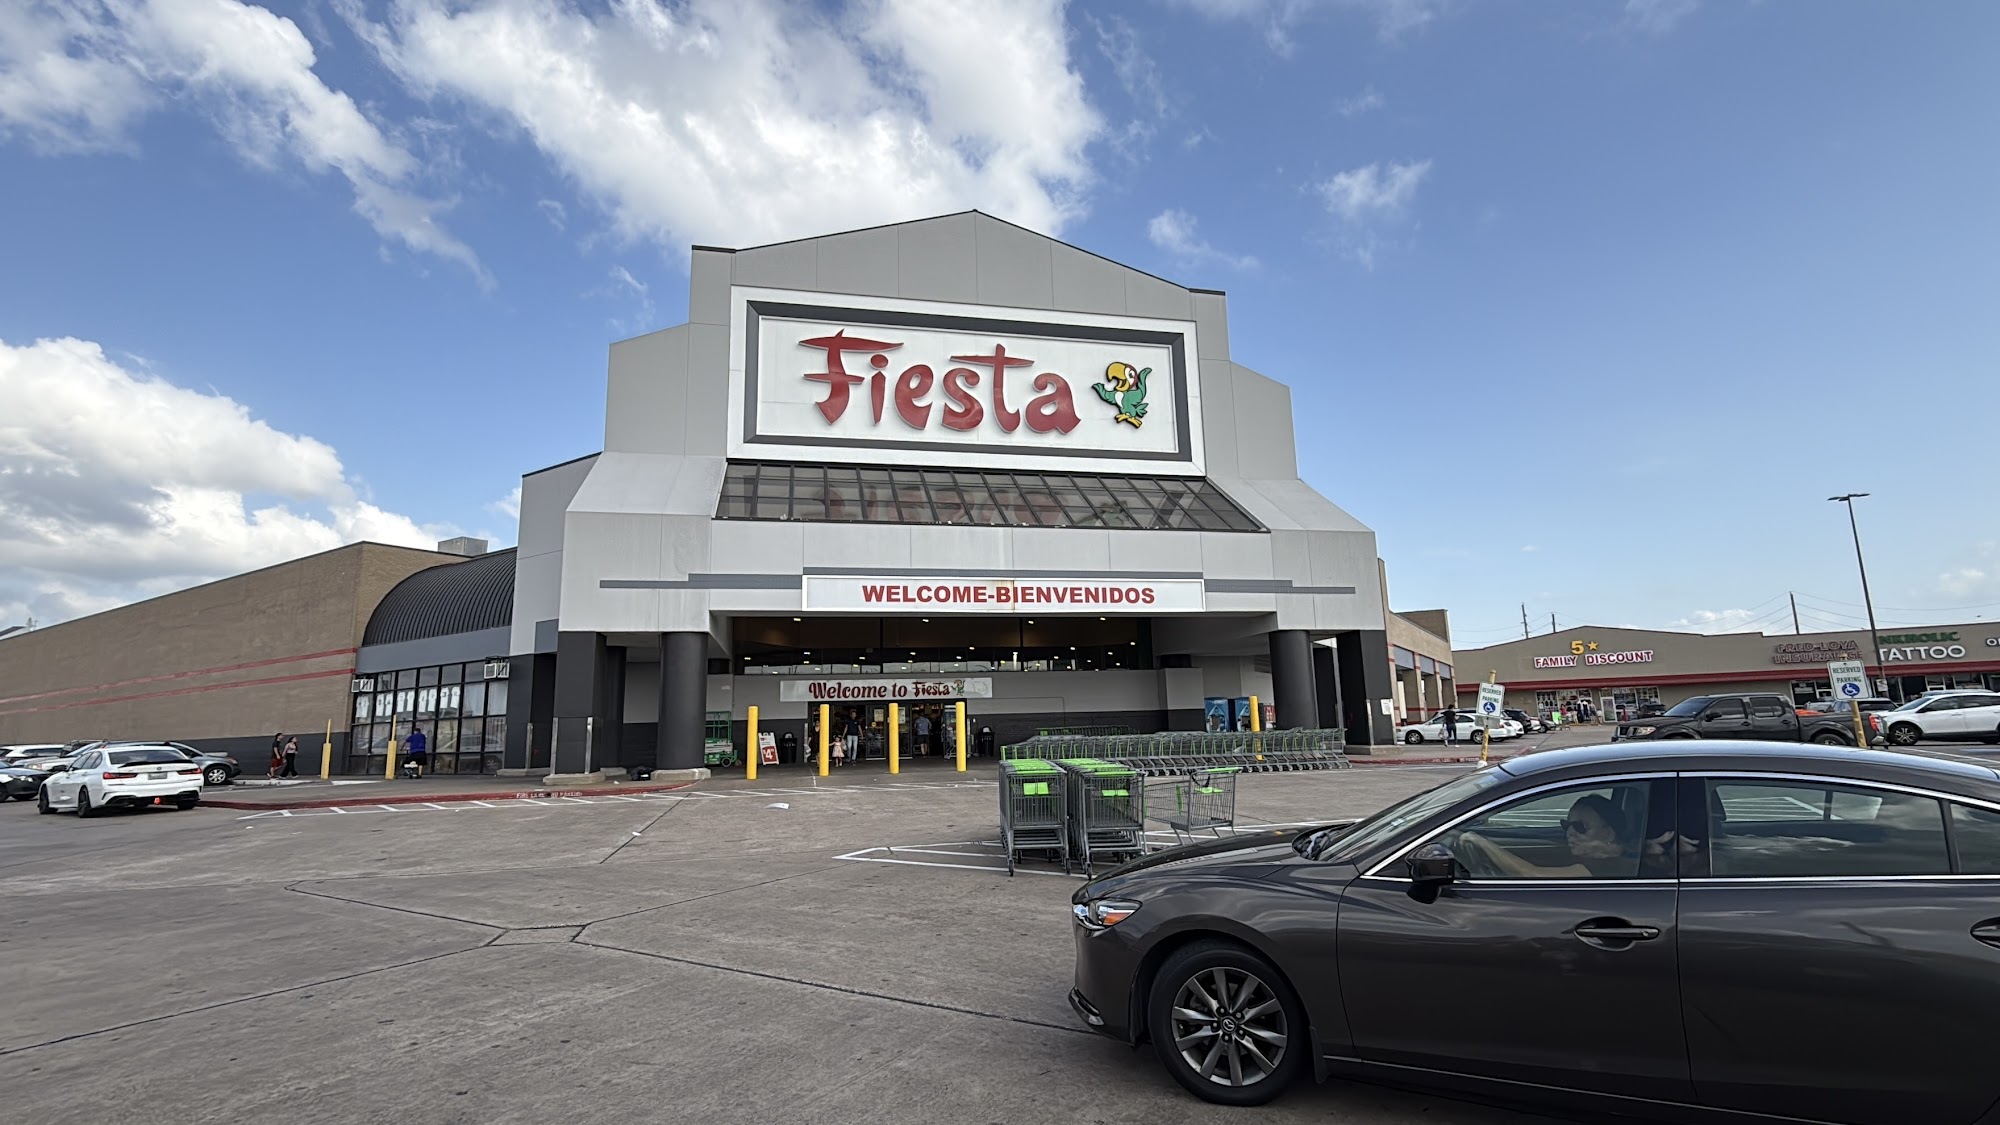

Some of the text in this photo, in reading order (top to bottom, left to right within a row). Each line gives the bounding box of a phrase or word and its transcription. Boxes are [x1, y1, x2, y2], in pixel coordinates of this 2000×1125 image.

[798, 328, 1082, 435] Fiesta
[862, 585, 1155, 604] WELCOME-BIENVENIDOS
[1571, 640, 1584, 655] 5
[1878, 645, 1966, 662] TATTOO
[1534, 650, 1654, 669] FAMILY DISCOUNT
[1832, 666, 1861, 674] RESERVED
[808, 681, 951, 699] Welcome to Fiesta
